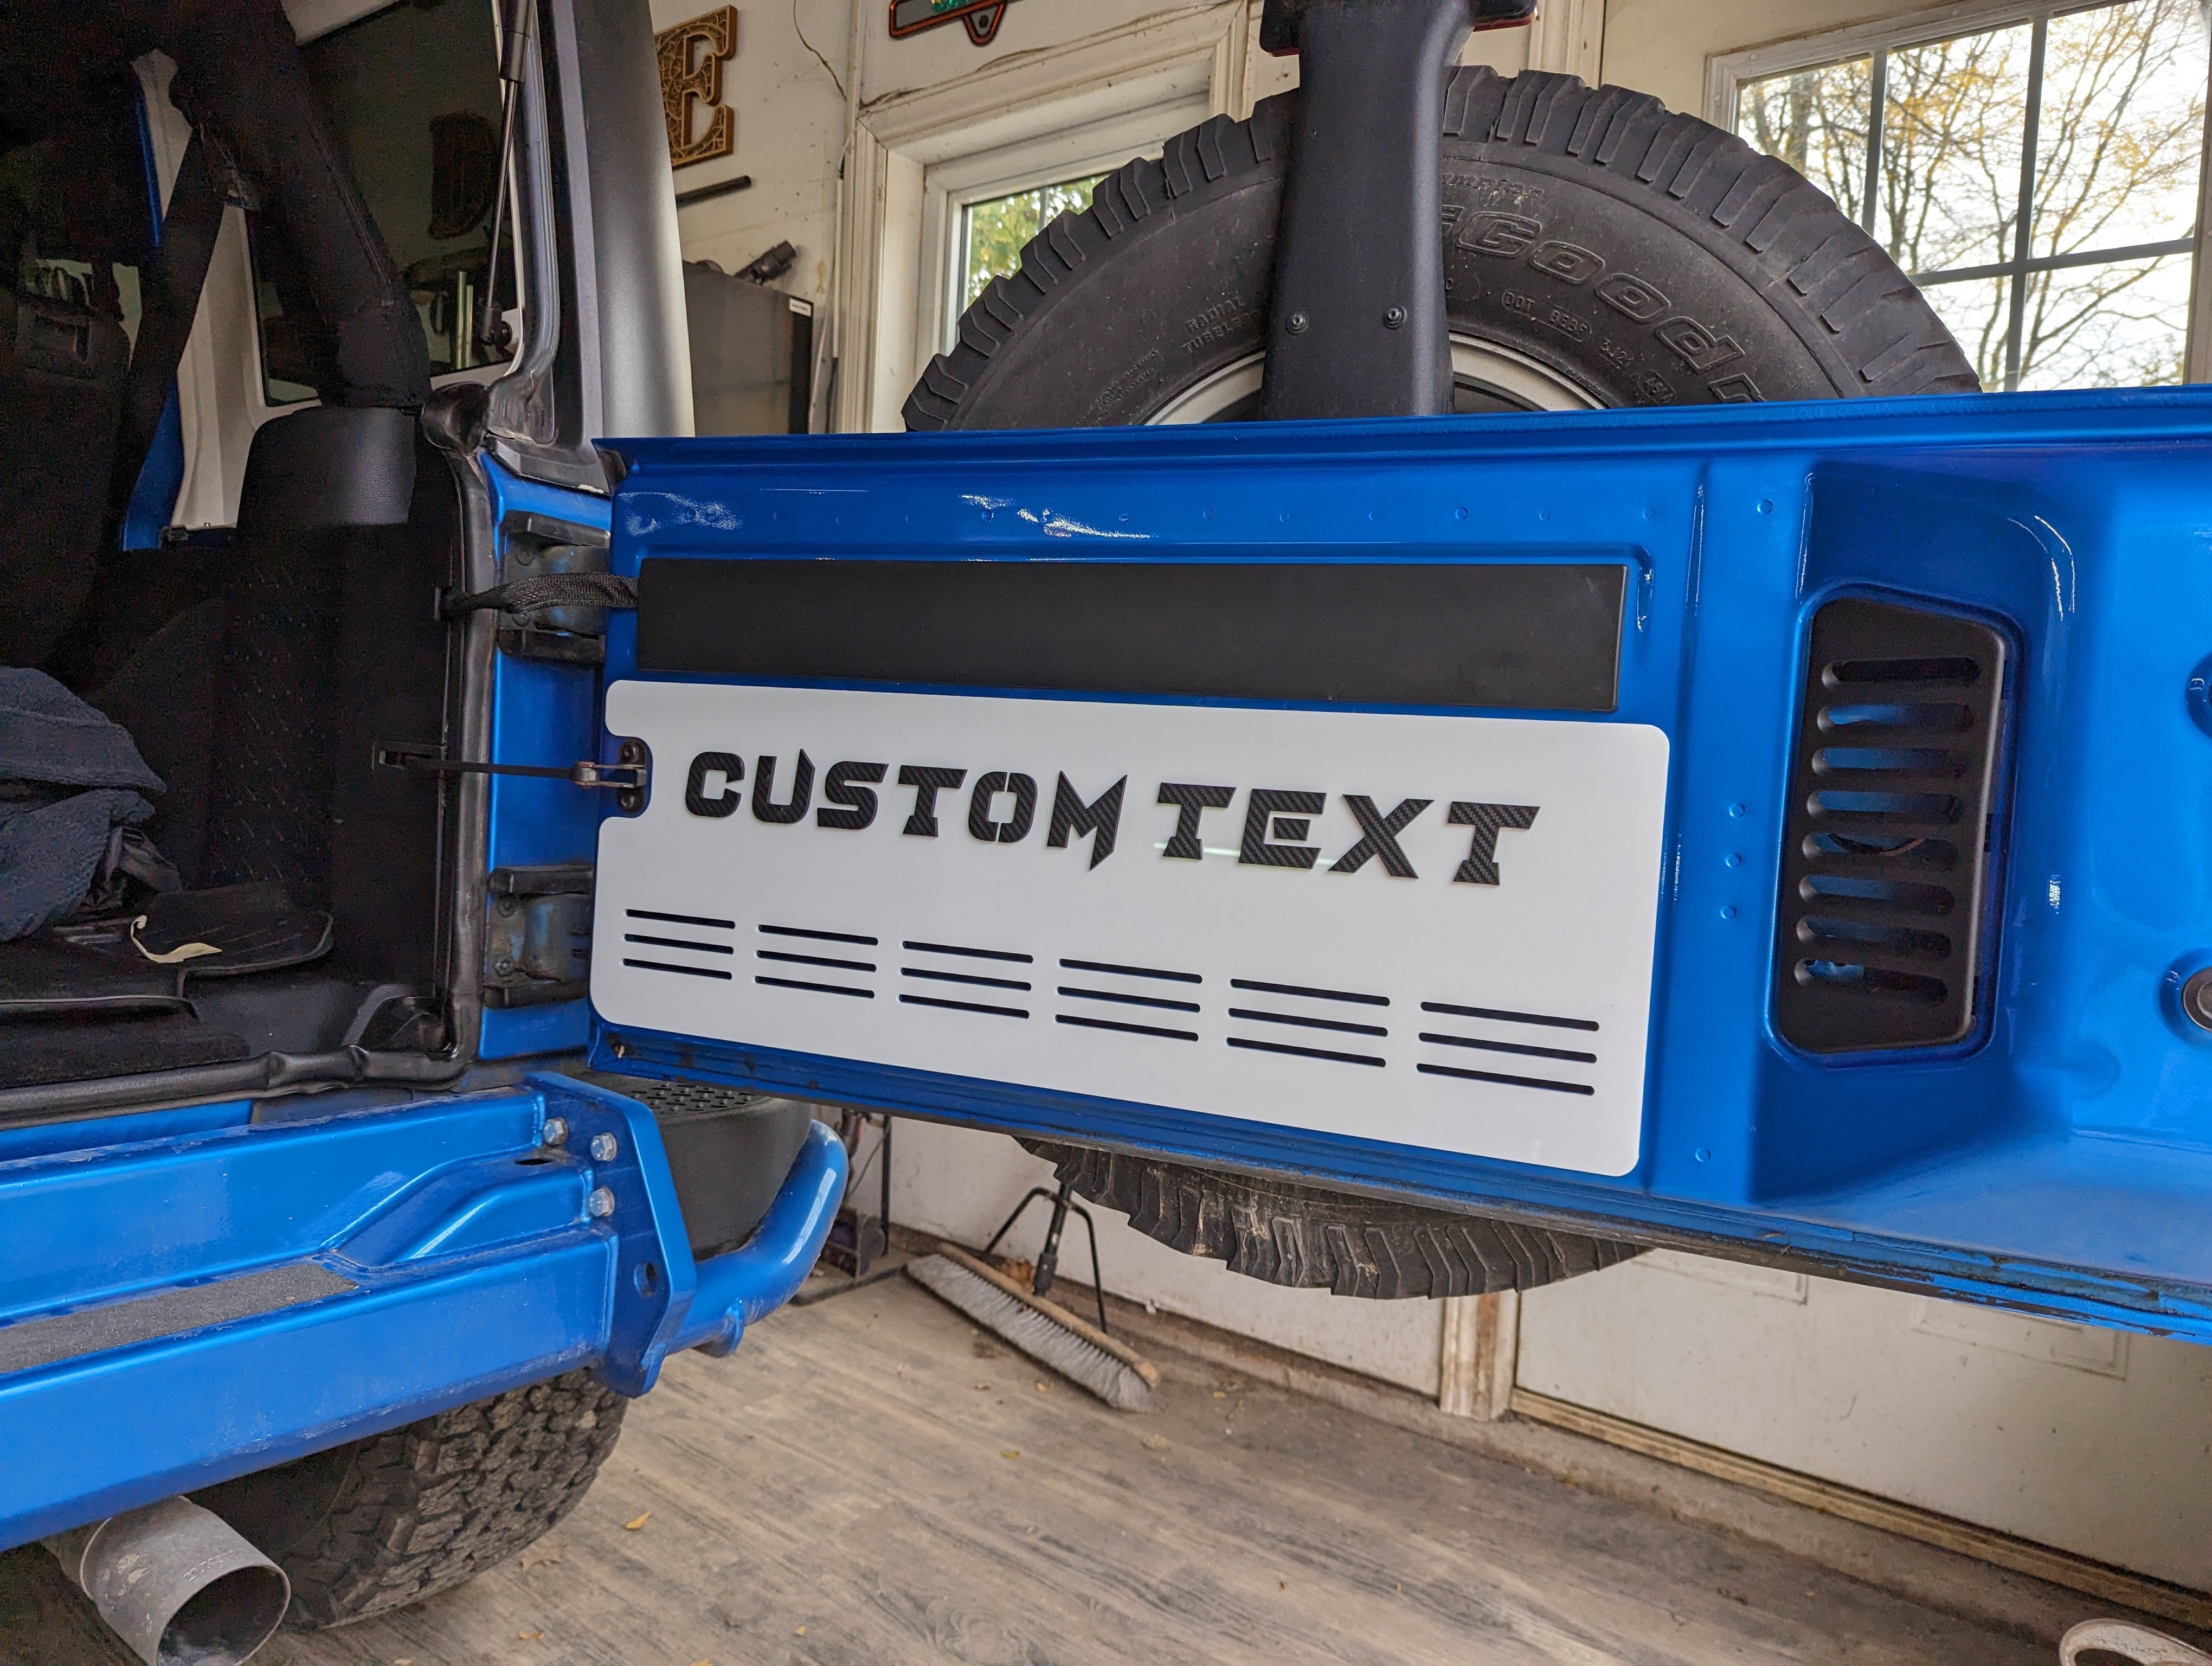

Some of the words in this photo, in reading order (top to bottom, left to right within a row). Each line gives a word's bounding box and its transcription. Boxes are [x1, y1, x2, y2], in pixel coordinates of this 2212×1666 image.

[1506, 292, 1535, 312] DOT
[685, 748, 1128, 871] CUSTOM
[1157, 782, 1541, 886] TEXT
